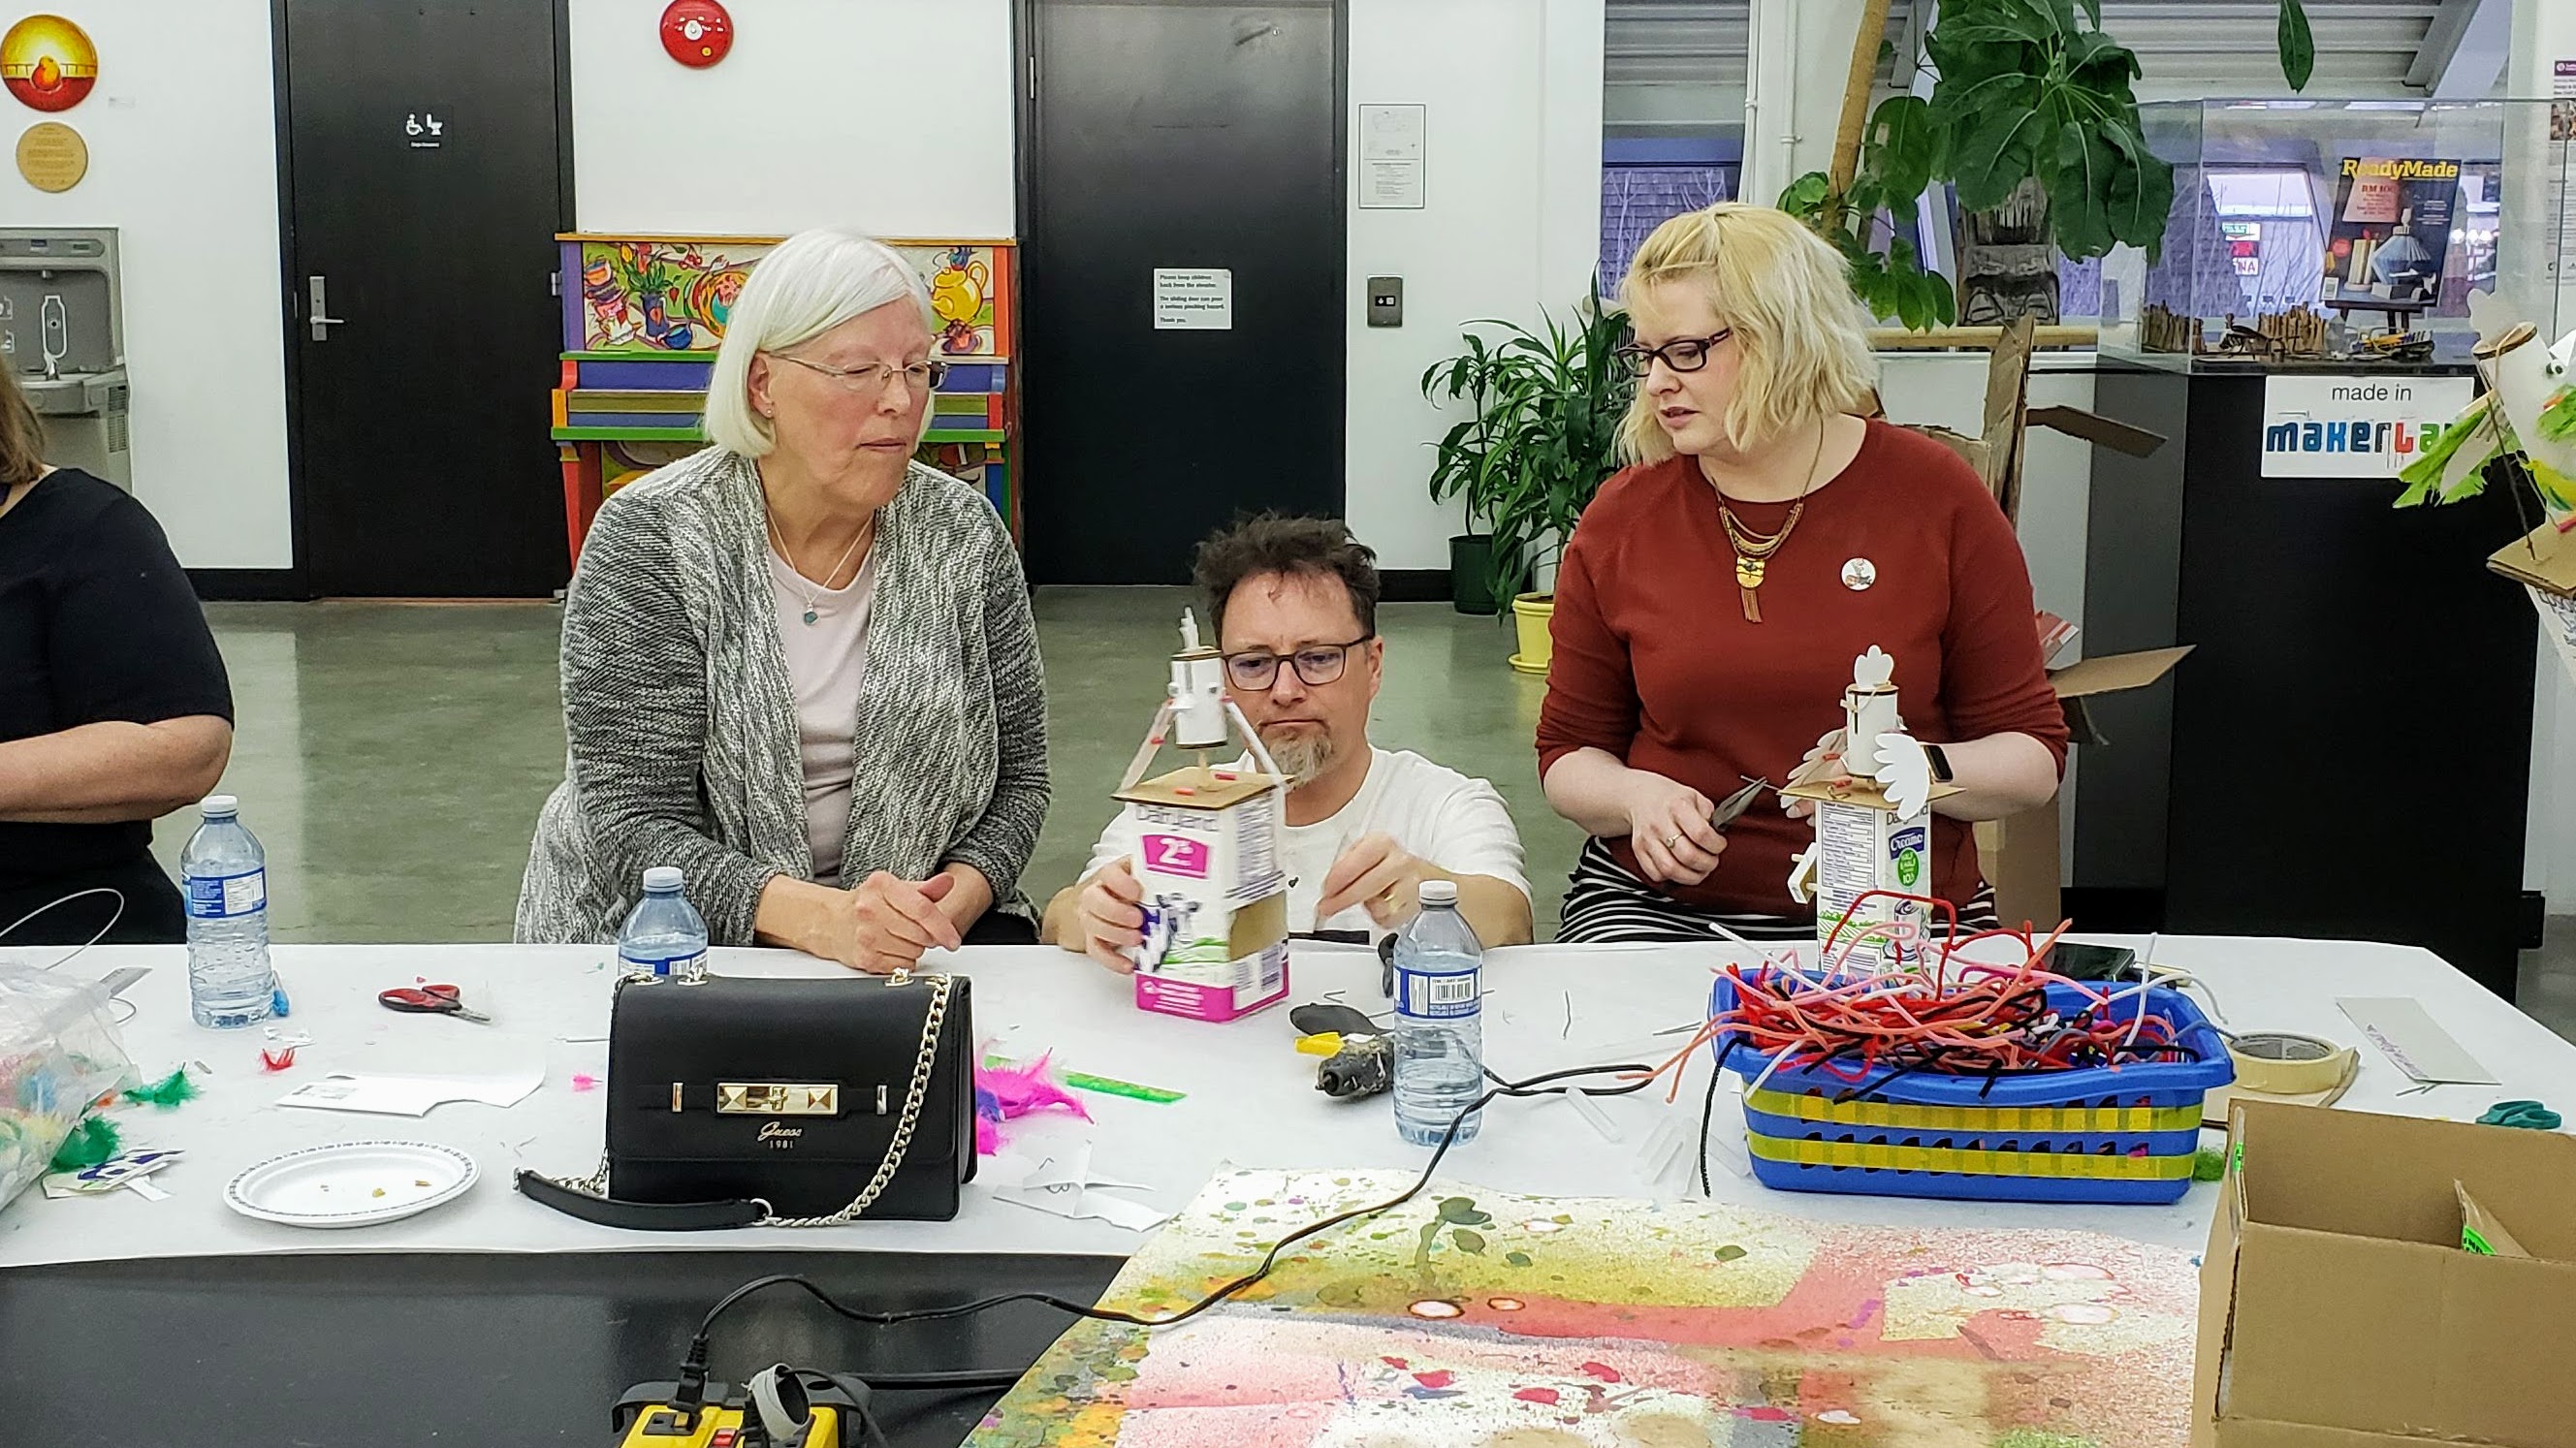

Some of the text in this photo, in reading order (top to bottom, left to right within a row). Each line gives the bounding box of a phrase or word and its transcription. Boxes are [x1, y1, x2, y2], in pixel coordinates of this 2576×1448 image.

[2341, 159, 2459, 180] ReadyMade
[2332, 383, 2412, 401] made in
[757, 1120, 802, 1142] Guess
[769, 1139, 793, 1149] 1981
